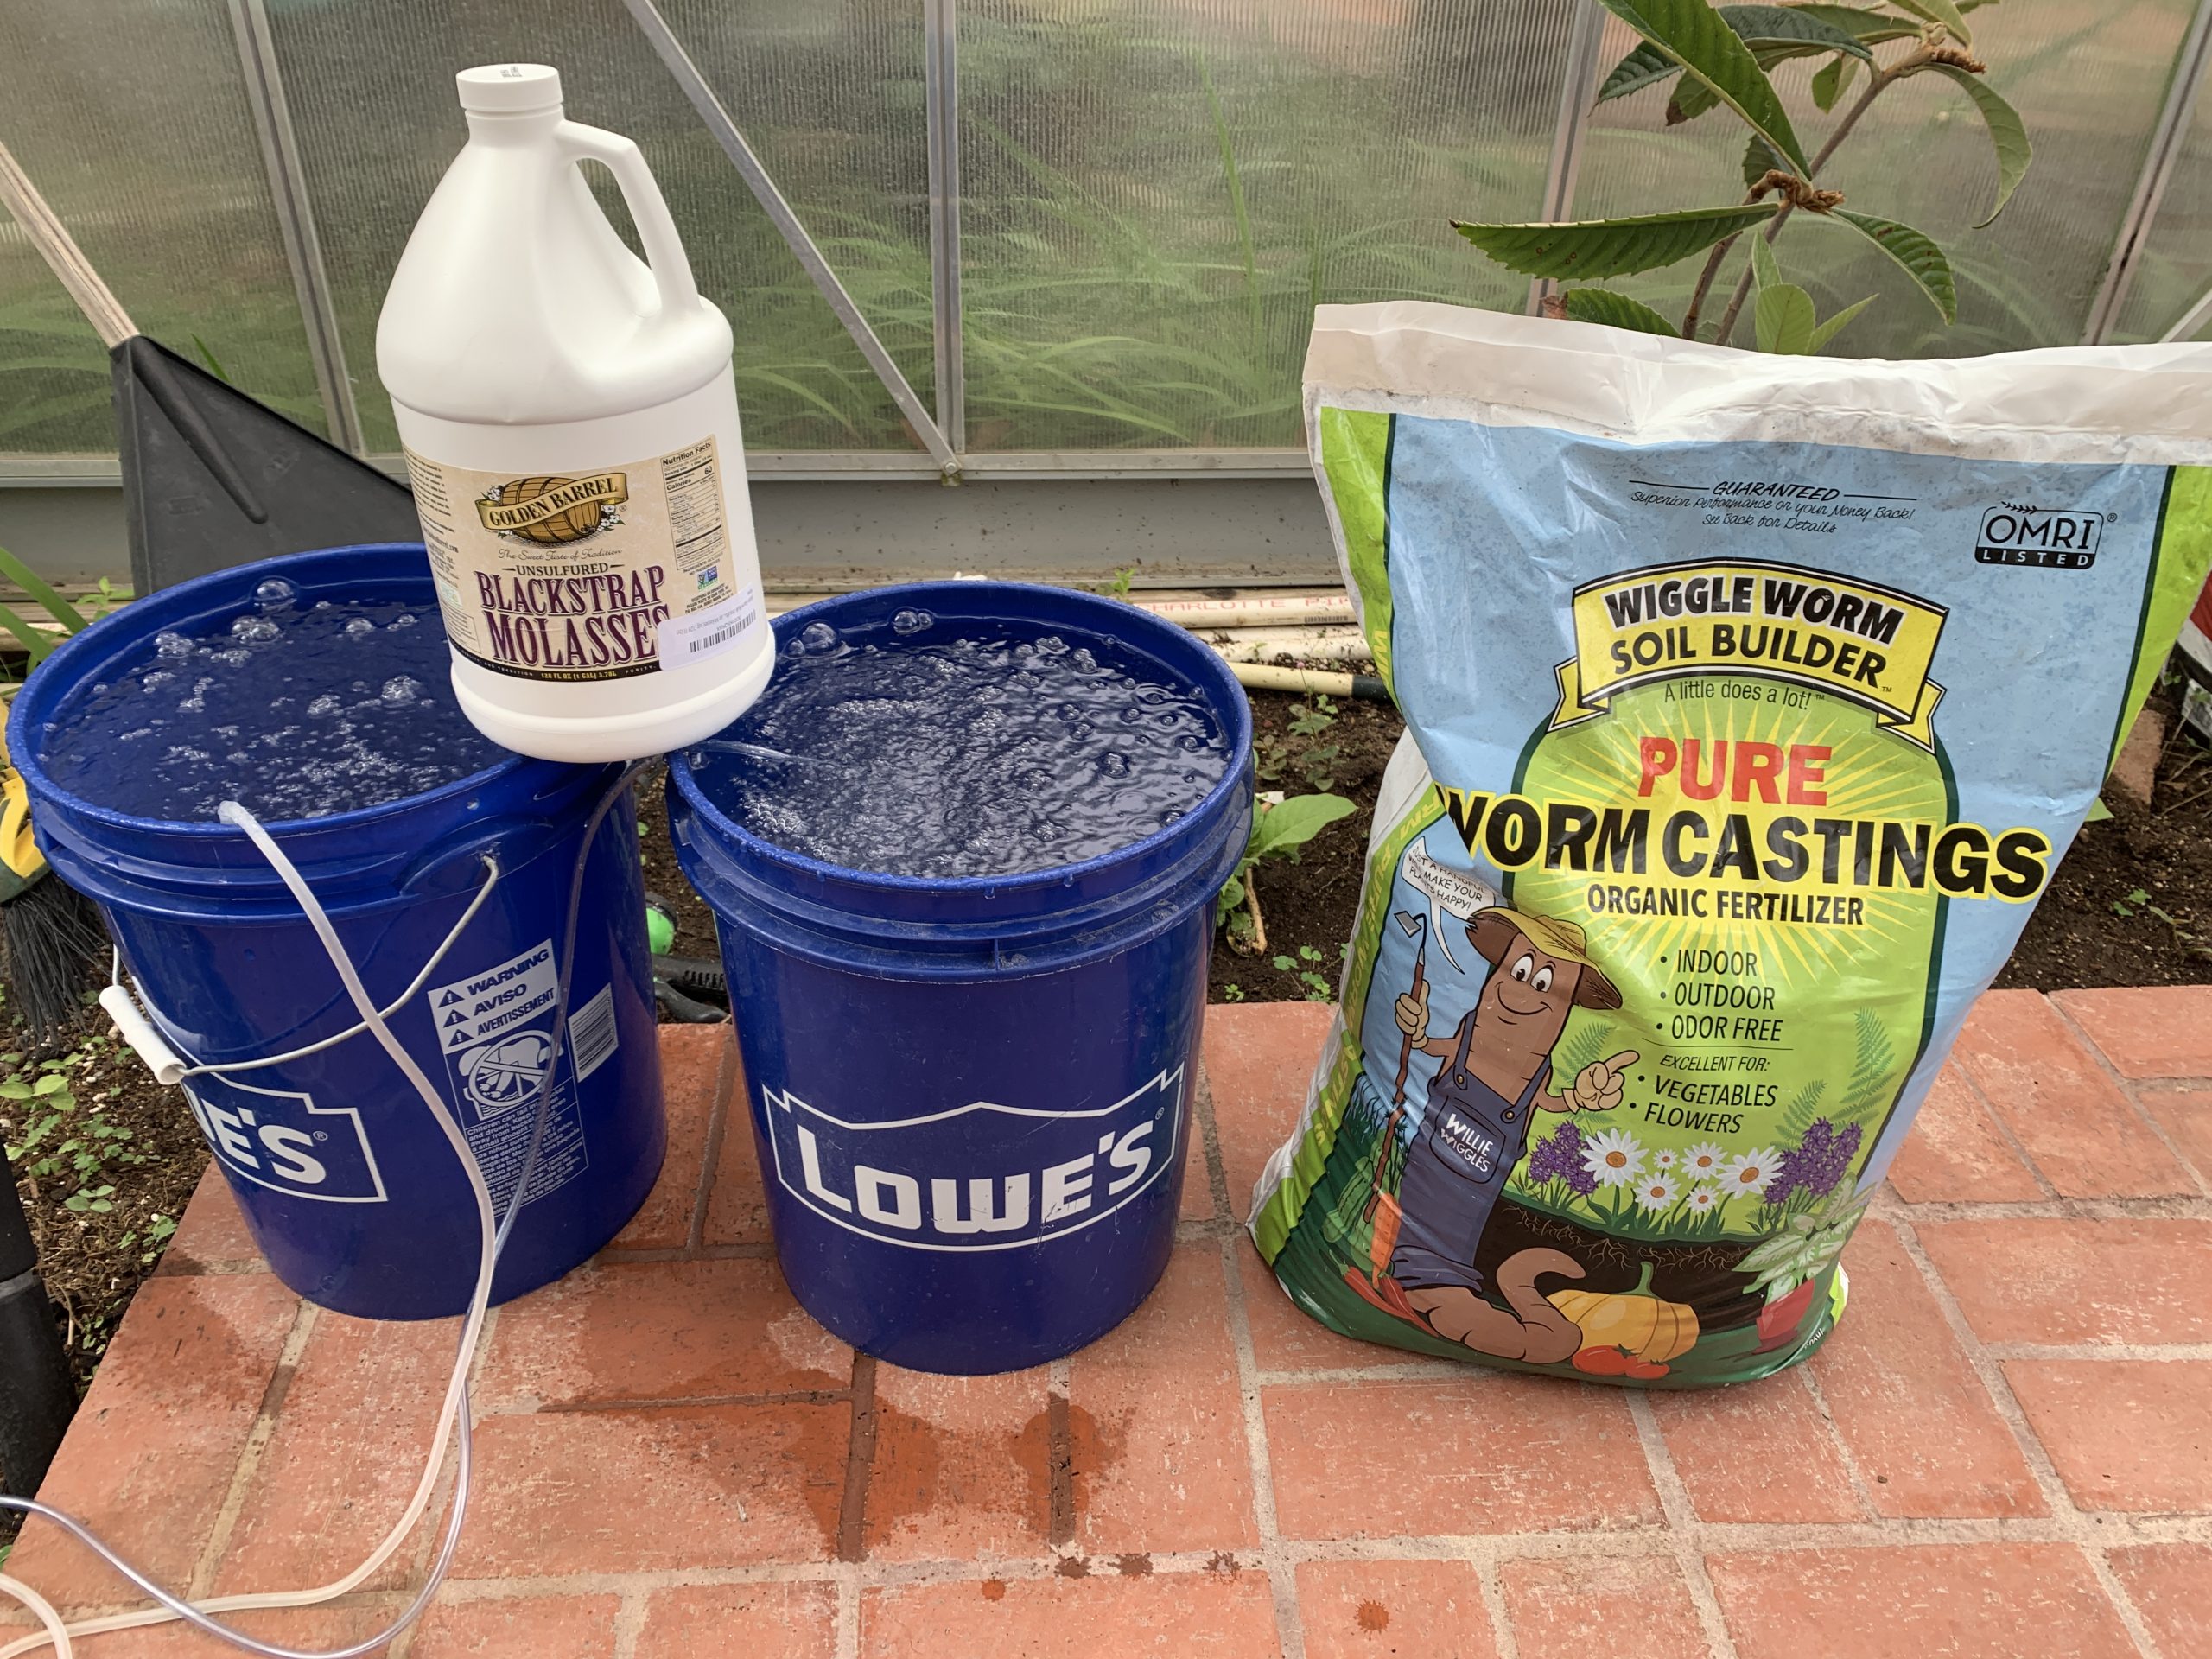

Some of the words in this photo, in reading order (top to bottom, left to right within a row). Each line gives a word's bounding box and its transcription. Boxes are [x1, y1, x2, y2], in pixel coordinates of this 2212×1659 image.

[662, 450, 694, 467] Nutrition
[695, 442, 711, 454] Facts
[666, 479, 691, 491] Calories
[704, 466, 713, 475] 60
[1713, 481, 1840, 501] GUARANTEED
[489, 499, 552, 526] GOLDEN
[550, 477, 618, 509] BARREL
[1630, 491, 1691, 509] Superior
[1795, 501, 1827, 517] your
[1829, 505, 1870, 521] Money
[1874, 506, 1915, 520] Back!
[1702, 513, 1720, 525] See
[1725, 512, 1753, 526] Back
[1757, 516, 1781, 528] for
[1784, 517, 1837, 534] Details
[1986, 514, 2095, 550] OMRI
[498, 549, 518, 560] The
[518, 550, 543, 561] Sweet
[545, 550, 568, 561] Taste
[570, 550, 578, 562] of
[581, 549, 622, 560] Tradition
[516, 563, 609, 576] UNSULFURED
[1983, 549, 2089, 566] LISTED
[474, 565, 664, 615] BLACKSTRAP
[1604, 576, 1755, 629] WIGGLE
[1764, 578, 1904, 645] WORM
[1611, 626, 1697, 676] SOIL
[1711, 623, 1887, 689] BUILDER
[1664, 684, 1675, 702] A
[1680, 681, 1715, 700] little
[1721, 680, 1761, 701] does
[1767, 688, 1777, 703] a
[1783, 688, 1812, 710] lot!
[1637, 736, 1832, 807] PURE
[1662, 810, 2048, 899] CASTINGS
[1424, 871, 1452, 889] MAKE
[1454, 882, 1483, 902] YOUR
[1437, 890, 1471, 911] HAPPY!
[1586, 883, 1710, 918] ORGANIC
[1716, 890, 1865, 925] FERTILIZER
[467, 949, 550, 995] WARNING
[1677, 949, 1758, 976] INDOOR
[474, 983, 527, 1016] AVISO
[1675, 982, 1776, 1011] OUTDOOR
[478, 988, 555, 1036] AVERTISSEMENT
[1671, 1014, 1729, 1039] ODOR
[1732, 1017, 1784, 1042] FREE
[1660, 1054, 1737, 1071] EXCELLENT
[1738, 1056, 1770, 1072] FOR:
[1654, 1074, 1778, 1107] VEGETABLES
[467, 1121, 500, 1135] Children
[469, 1133, 484, 1141] and
[486, 1123, 512, 1135] drown.
[512, 1113, 531, 1124] Keep
[1644, 1102, 1745, 1134] FLOWERS
[470, 1136, 490, 1147] away
[492, 1130, 510, 1139] from
[478, 1139, 499, 1149] small
[501, 1126, 528, 1141] amount
[1446, 1113, 1493, 1156] WILLIE
[1440, 1128, 1491, 1172] WIGGLES
[797, 1120, 1154, 1234] LOWE'S
